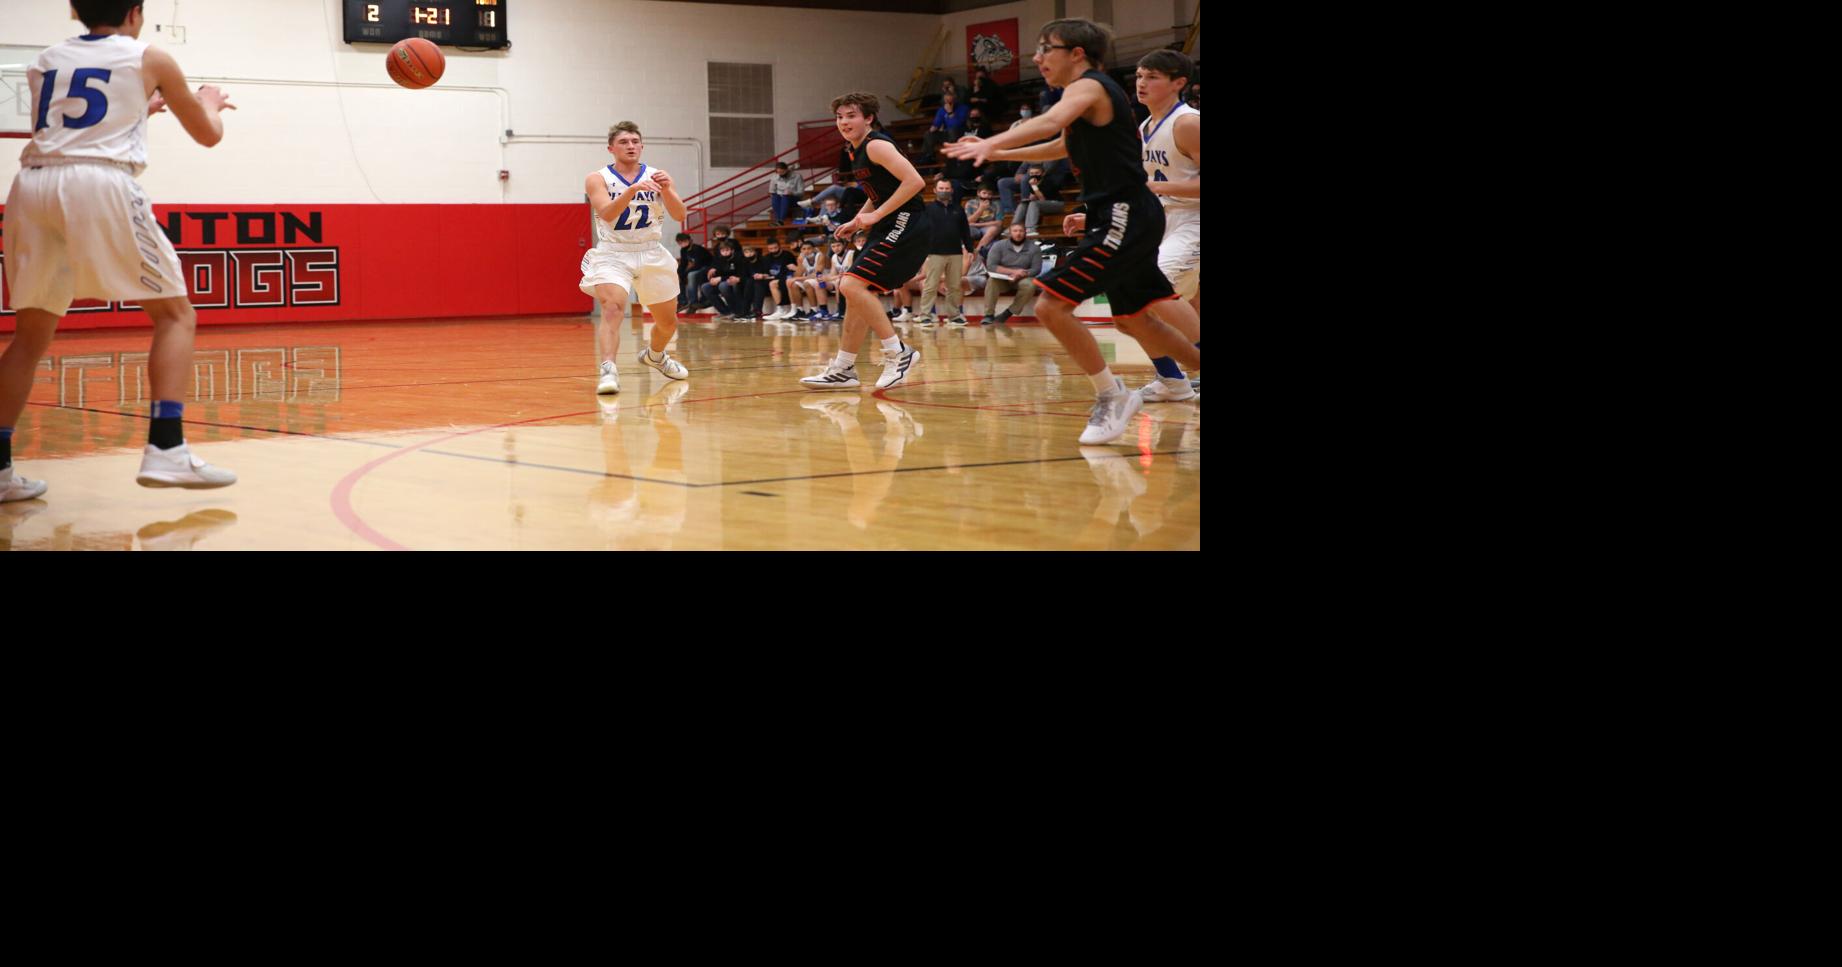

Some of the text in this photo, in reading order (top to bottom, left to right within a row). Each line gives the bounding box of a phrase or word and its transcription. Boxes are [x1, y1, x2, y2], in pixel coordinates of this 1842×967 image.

[367, 4, 380, 22] 2
[35, 67, 112, 132] 15
[1141, 150, 1169, 167] JAYS
[613, 204, 653, 231] 22
[885, 211, 911, 243] TROJANS
